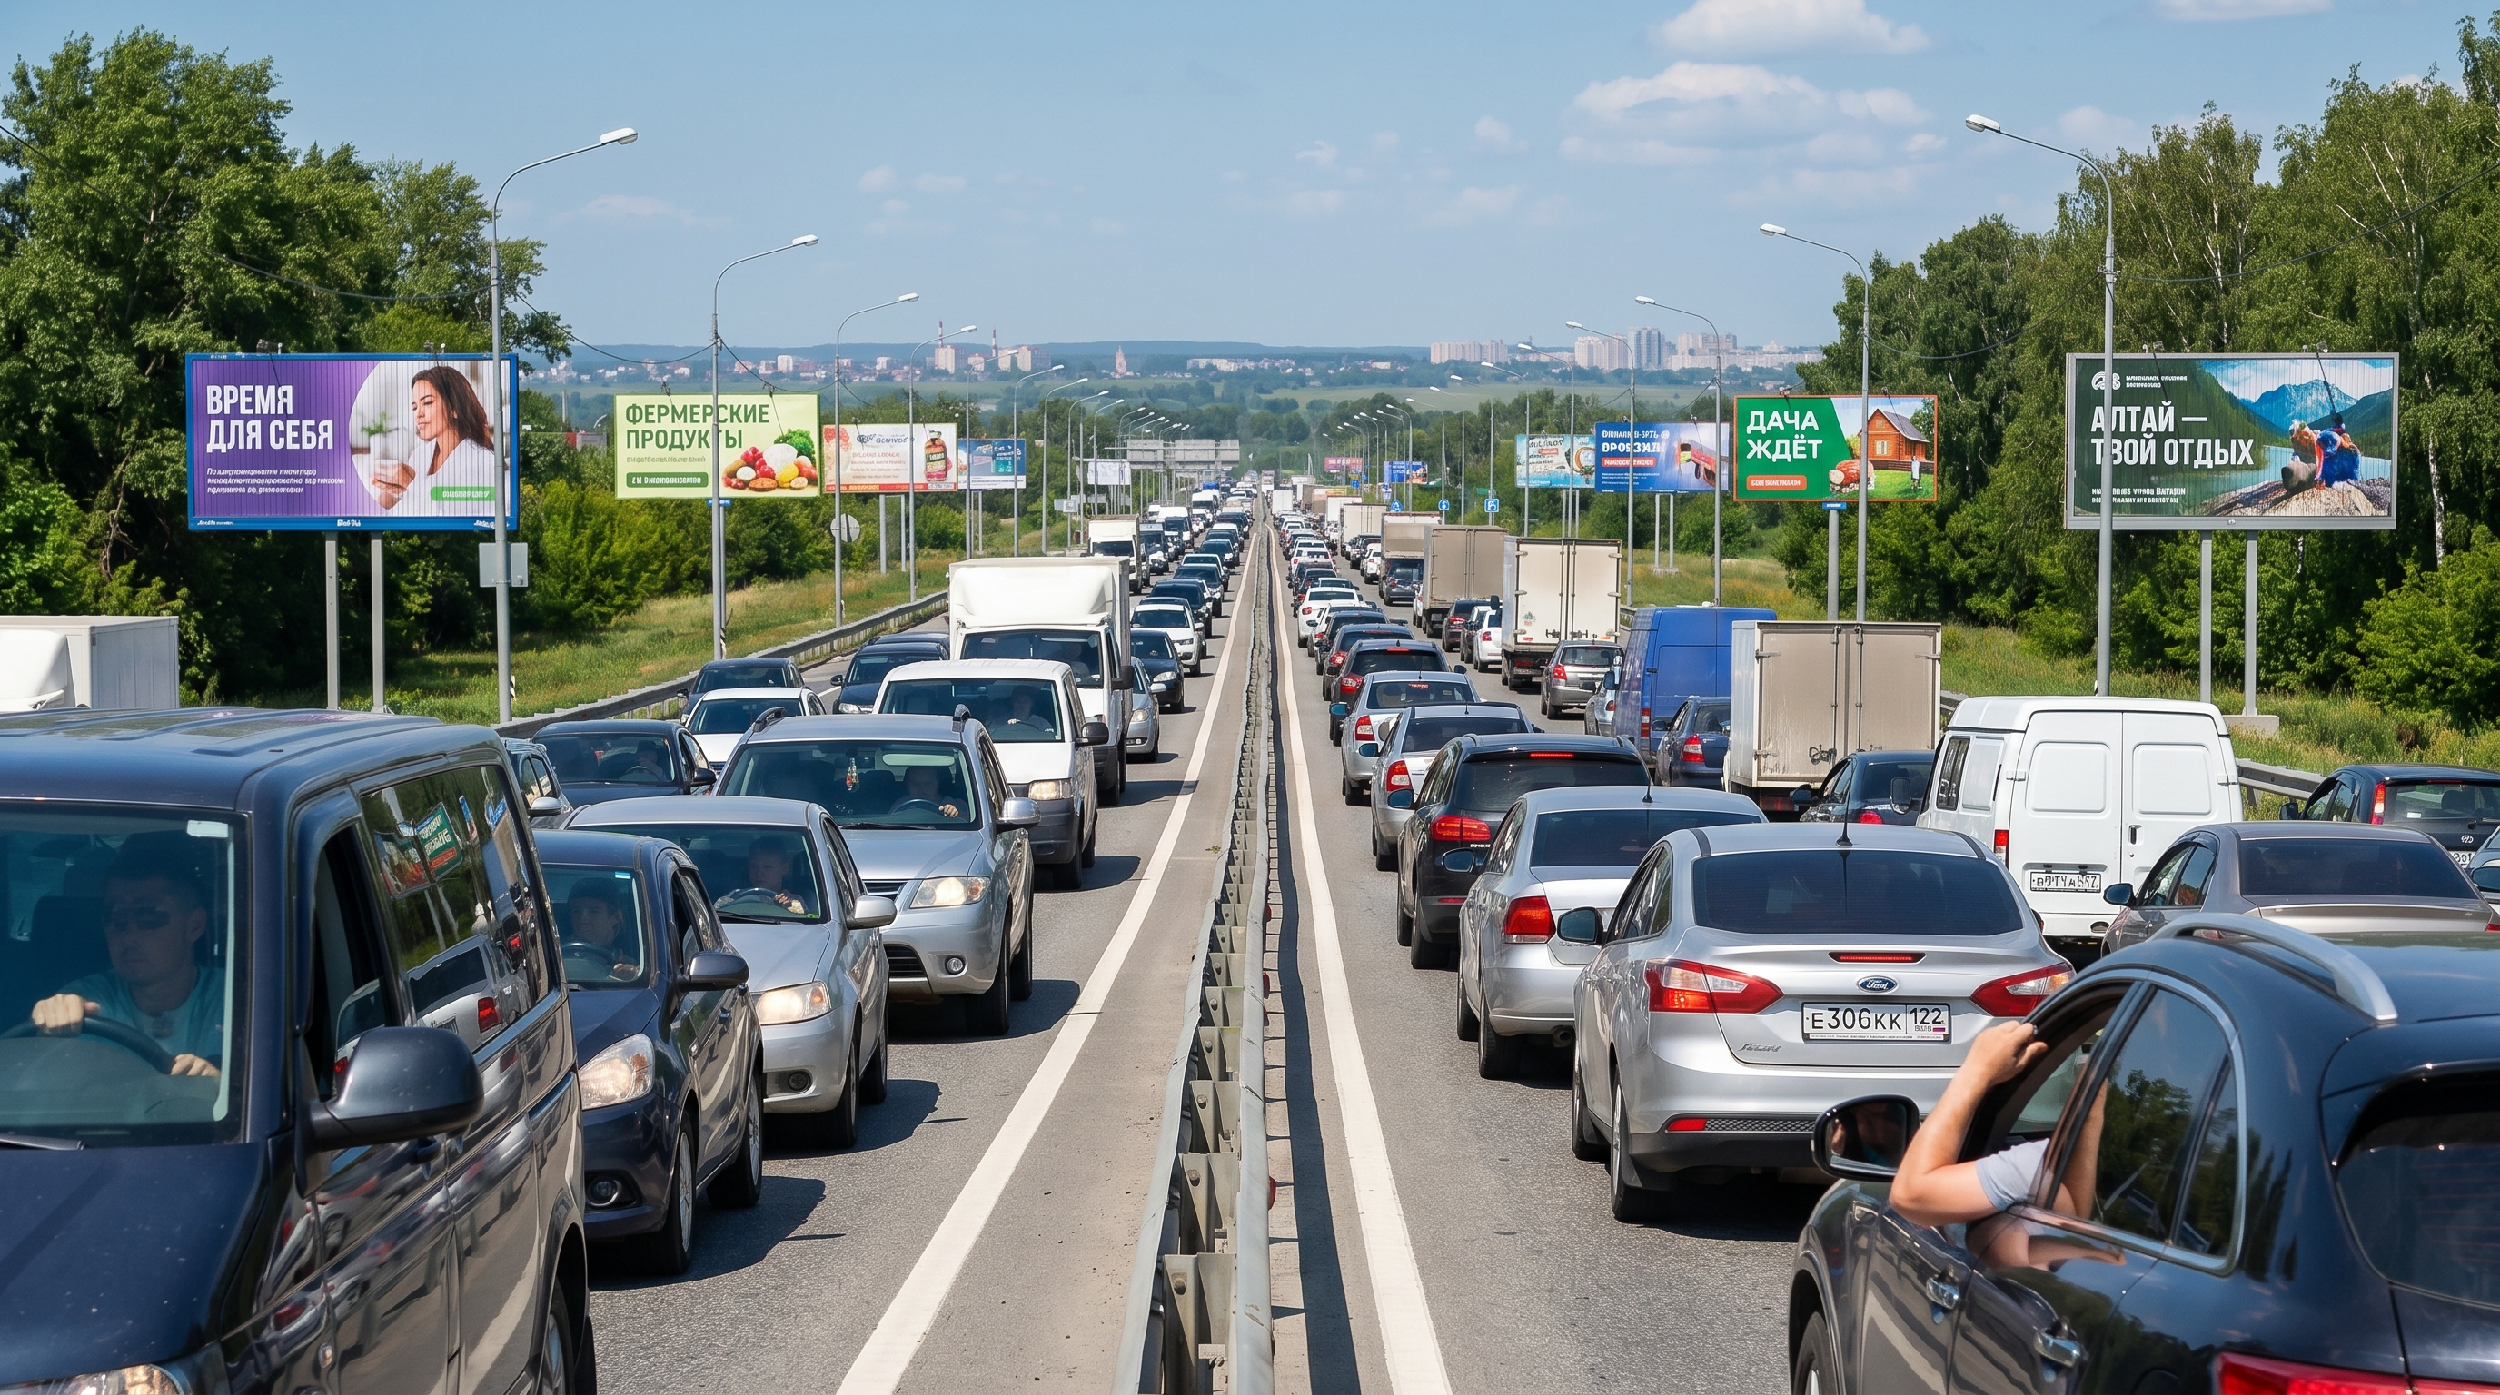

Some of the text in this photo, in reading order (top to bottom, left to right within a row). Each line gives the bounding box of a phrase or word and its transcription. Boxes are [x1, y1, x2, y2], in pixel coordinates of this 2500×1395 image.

[206, 385, 294, 415] ВРЕМЯ
[625, 403, 770, 425] ФЕРМЕРСКИЕ
[1746, 410, 1819, 434] ДАЧА
[2090, 400, 2175, 432] АЛТАЙ
[206, 419, 333, 453] ДЛЯ СЕБЯ
[626, 429, 743, 451] ПРОДУКЫ
[1746, 434, 1822, 462] ЖДЁТ
[2090, 432, 2255, 469] ТВОЙ ОТДЫХ
[1909, 1007, 1942, 1025] 122
